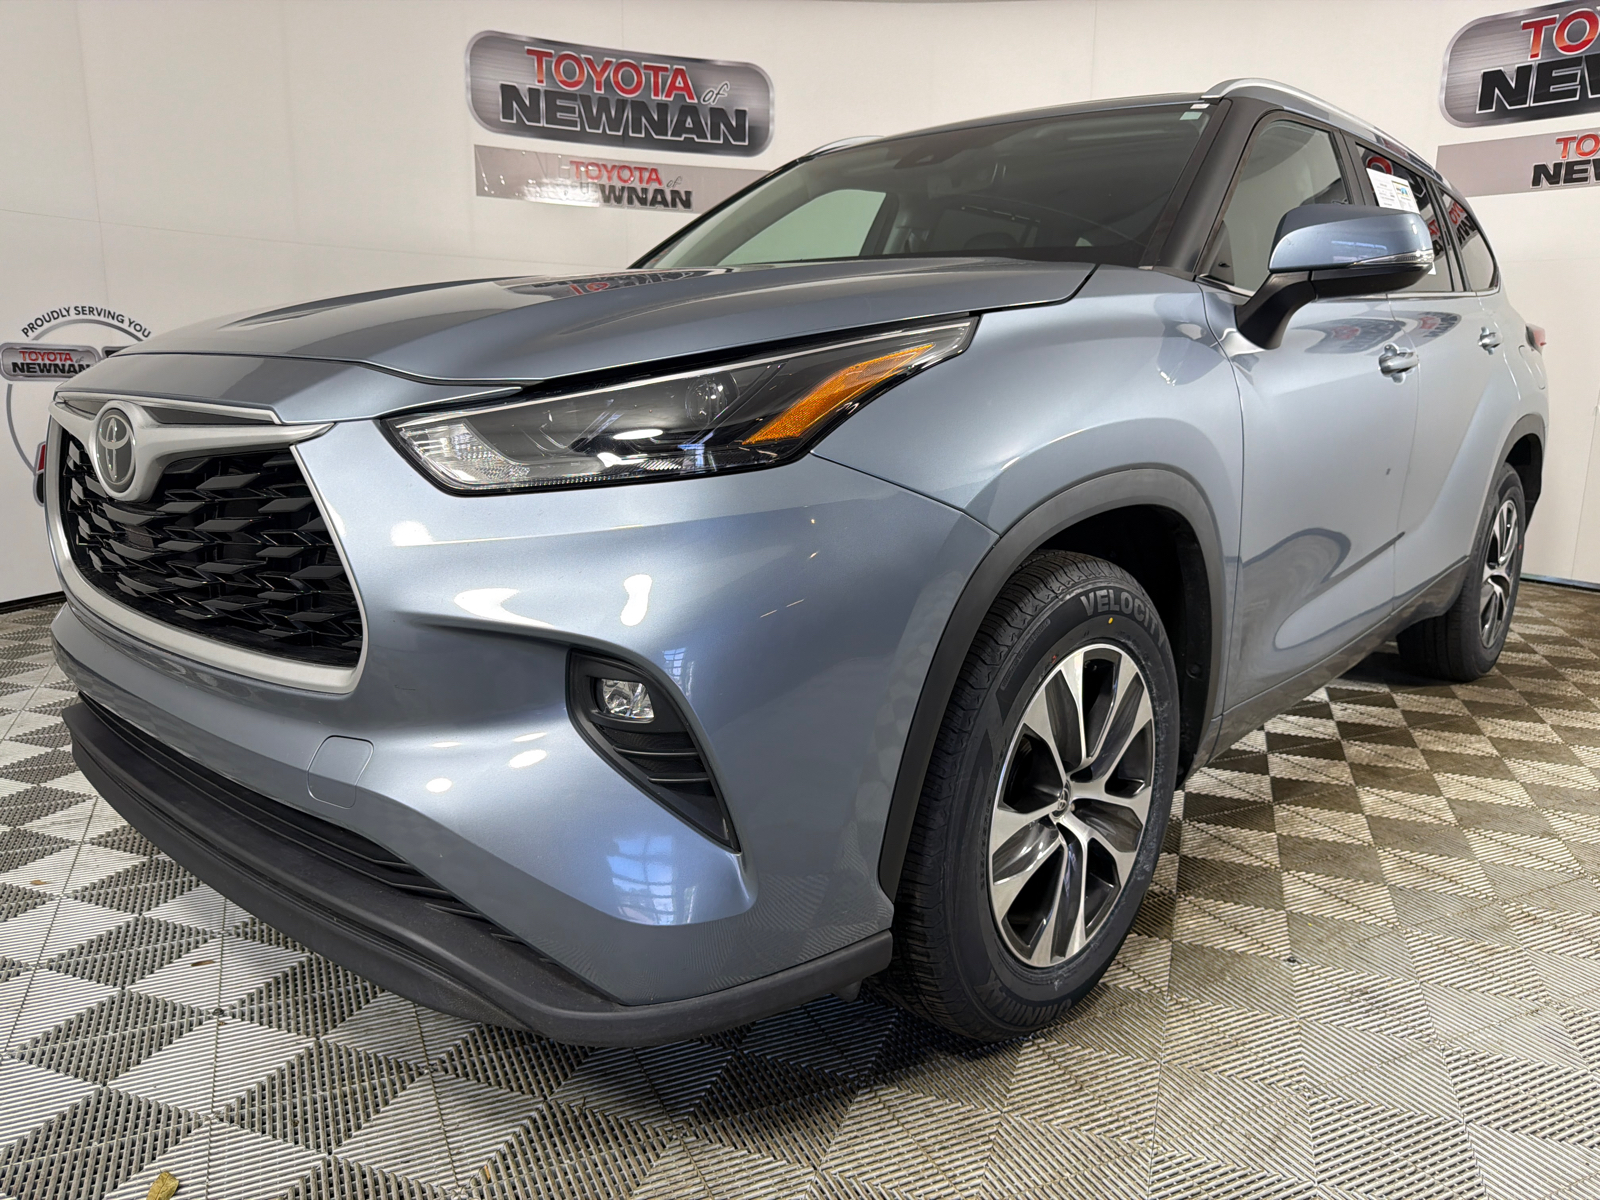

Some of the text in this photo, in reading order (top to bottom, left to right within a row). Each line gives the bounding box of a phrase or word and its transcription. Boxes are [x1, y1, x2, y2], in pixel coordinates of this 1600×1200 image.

[1521, 7, 1600, 61] TO
[525, 46, 730, 105] TOYOTA of
[499, 83, 749, 146] NEWNAN
[1555, 132, 1600, 160] TO
[569, 160, 682, 189] TOYOTA of
[21, 305, 151, 338] PROUDLY SERVING YOU
[19, 350, 74, 363] TOYOTA
[1080, 589, 1166, 648] VELOCITY
